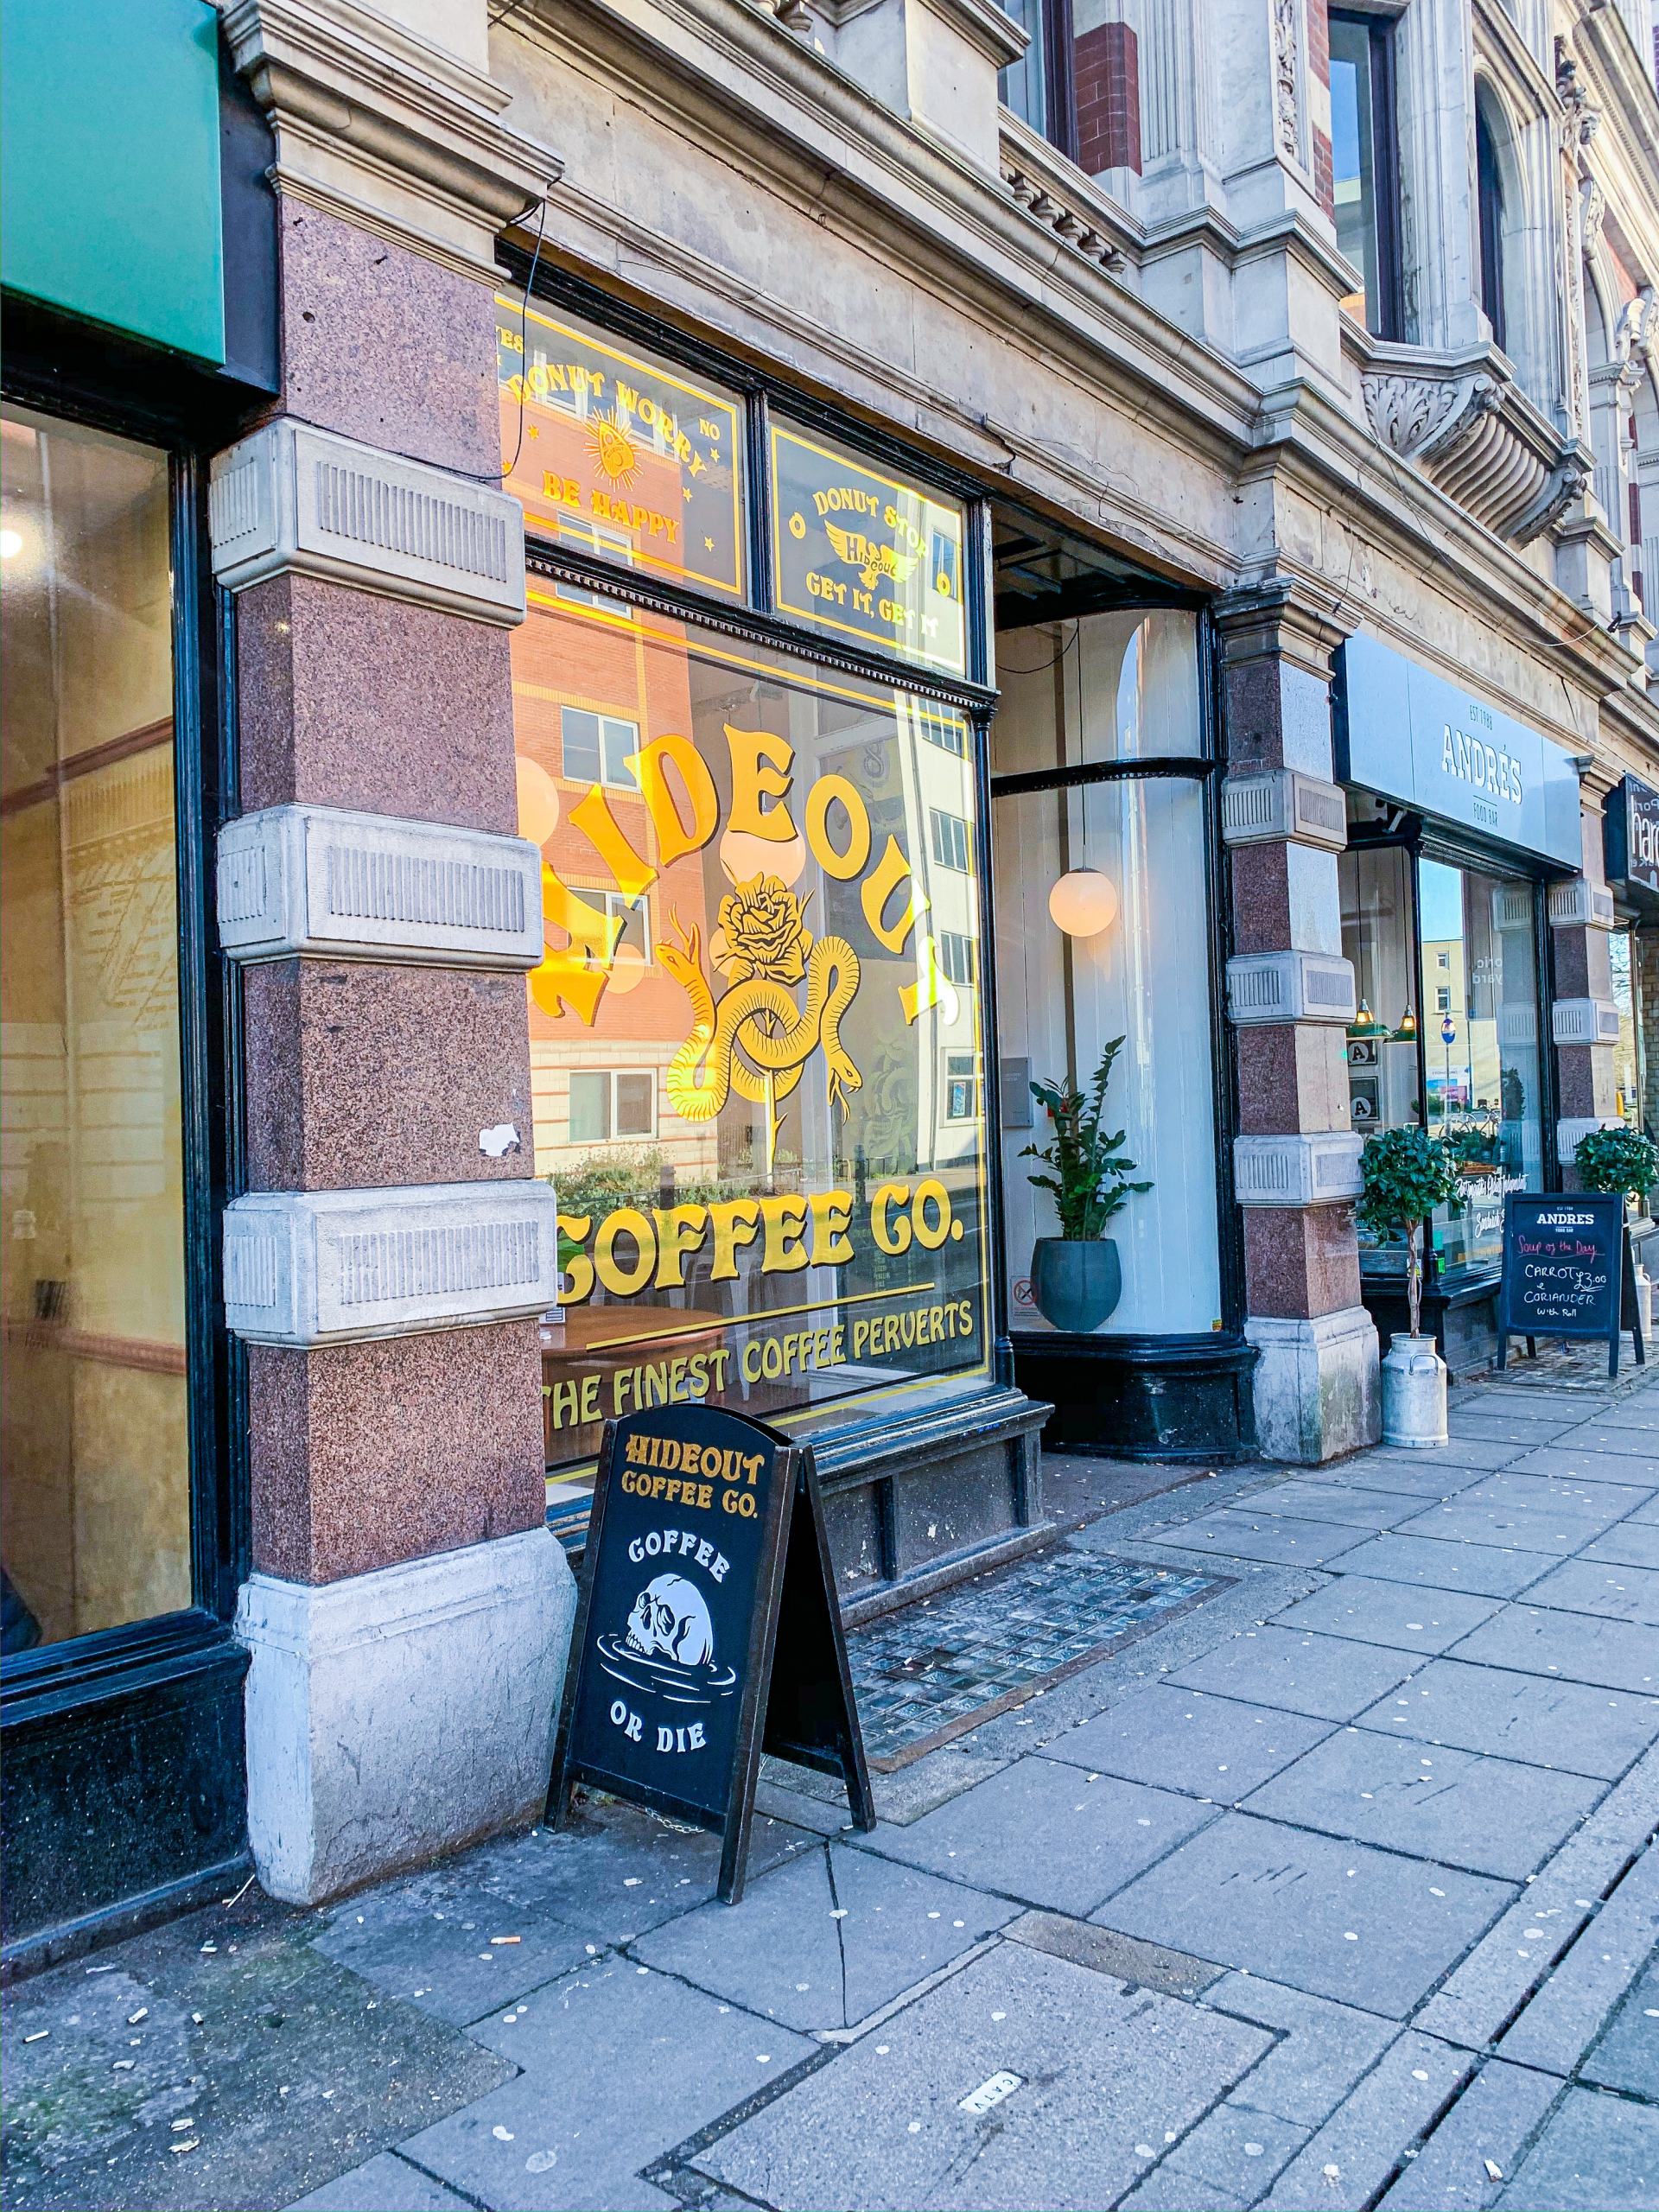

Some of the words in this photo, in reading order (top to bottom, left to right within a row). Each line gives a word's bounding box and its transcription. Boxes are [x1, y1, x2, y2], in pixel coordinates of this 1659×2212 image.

[496, 326, 524, 354] ES
[506, 364, 605, 405] DONUT
[616, 379, 709, 477] WORRY
[698, 418, 721, 441] NO
[543, 470, 581, 508] BE
[590, 489, 680, 544] HAPPY
[812, 487, 879, 518] DONUT
[884, 505, 929, 558] STOP
[805, 571, 847, 605] GET
[852, 588, 874, 619] IT,
[879, 599, 915, 629] GET
[920, 614, 938, 639] IT
[526, 723, 960, 1027] HIDEOUT
[1352, 1046, 1364, 1061] A
[1355, 1101, 1368, 1116] A
[556, 1190, 856, 1306] COFFEE
[870, 1179, 964, 1257] CO.
[1518, 1235, 1541, 1255] Soup
[1546, 1243, 1555, 1255] of
[1560, 1240, 1572, 1251] the
[1576, 1240, 1597, 1263] Day
[1524, 1291, 1596, 1305] CORIANDER
[1525, 1264, 1580, 1280] CARROT
[613, 1348, 730, 1416] FINEST
[742, 1325, 846, 1383] COFFEE
[854, 1300, 974, 1360] PERVERTS
[625, 1433, 766, 1485] HIDEOUT
[621, 1471, 713, 1509] COFFEE
[722, 1491, 760, 1519] CO.
[628, 1529, 733, 1584] COFFEE
[610, 1700, 643, 1742] OR
[657, 1721, 708, 1753] DIE
